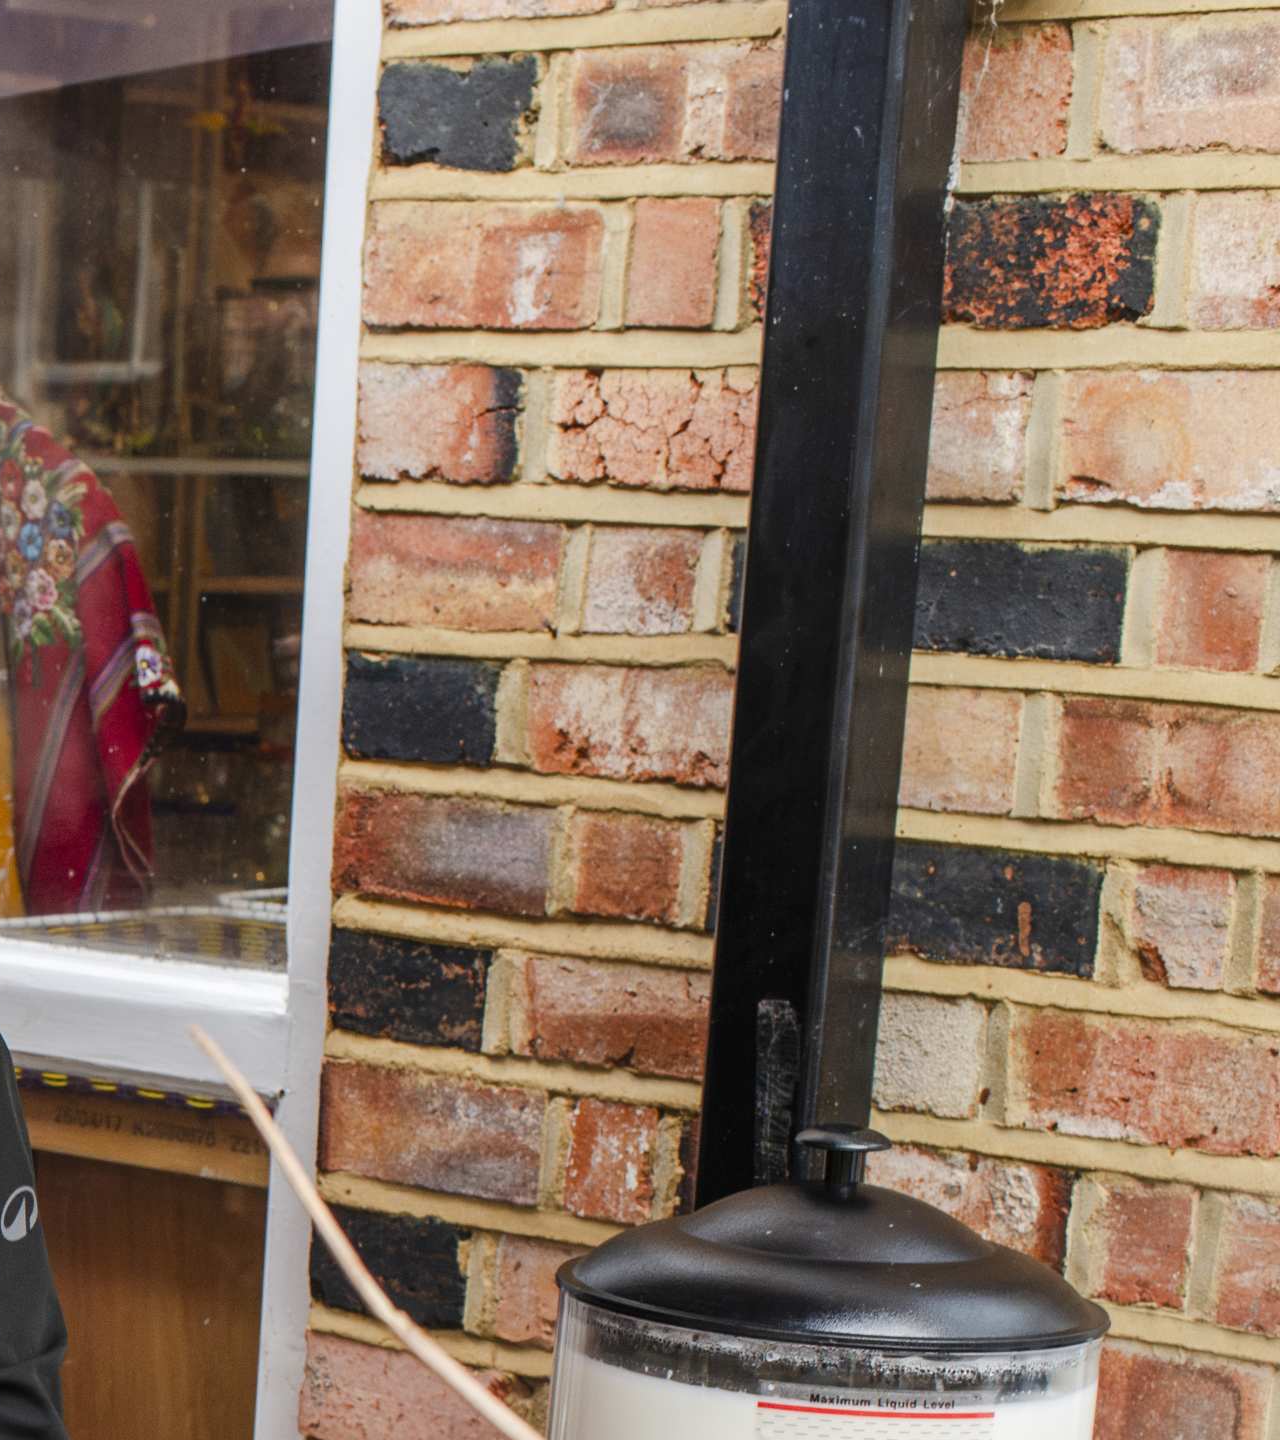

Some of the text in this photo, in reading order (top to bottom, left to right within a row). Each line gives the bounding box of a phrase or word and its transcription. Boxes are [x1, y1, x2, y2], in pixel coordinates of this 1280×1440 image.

[809, 1393, 955, 1410] Maximum Liquid Level
